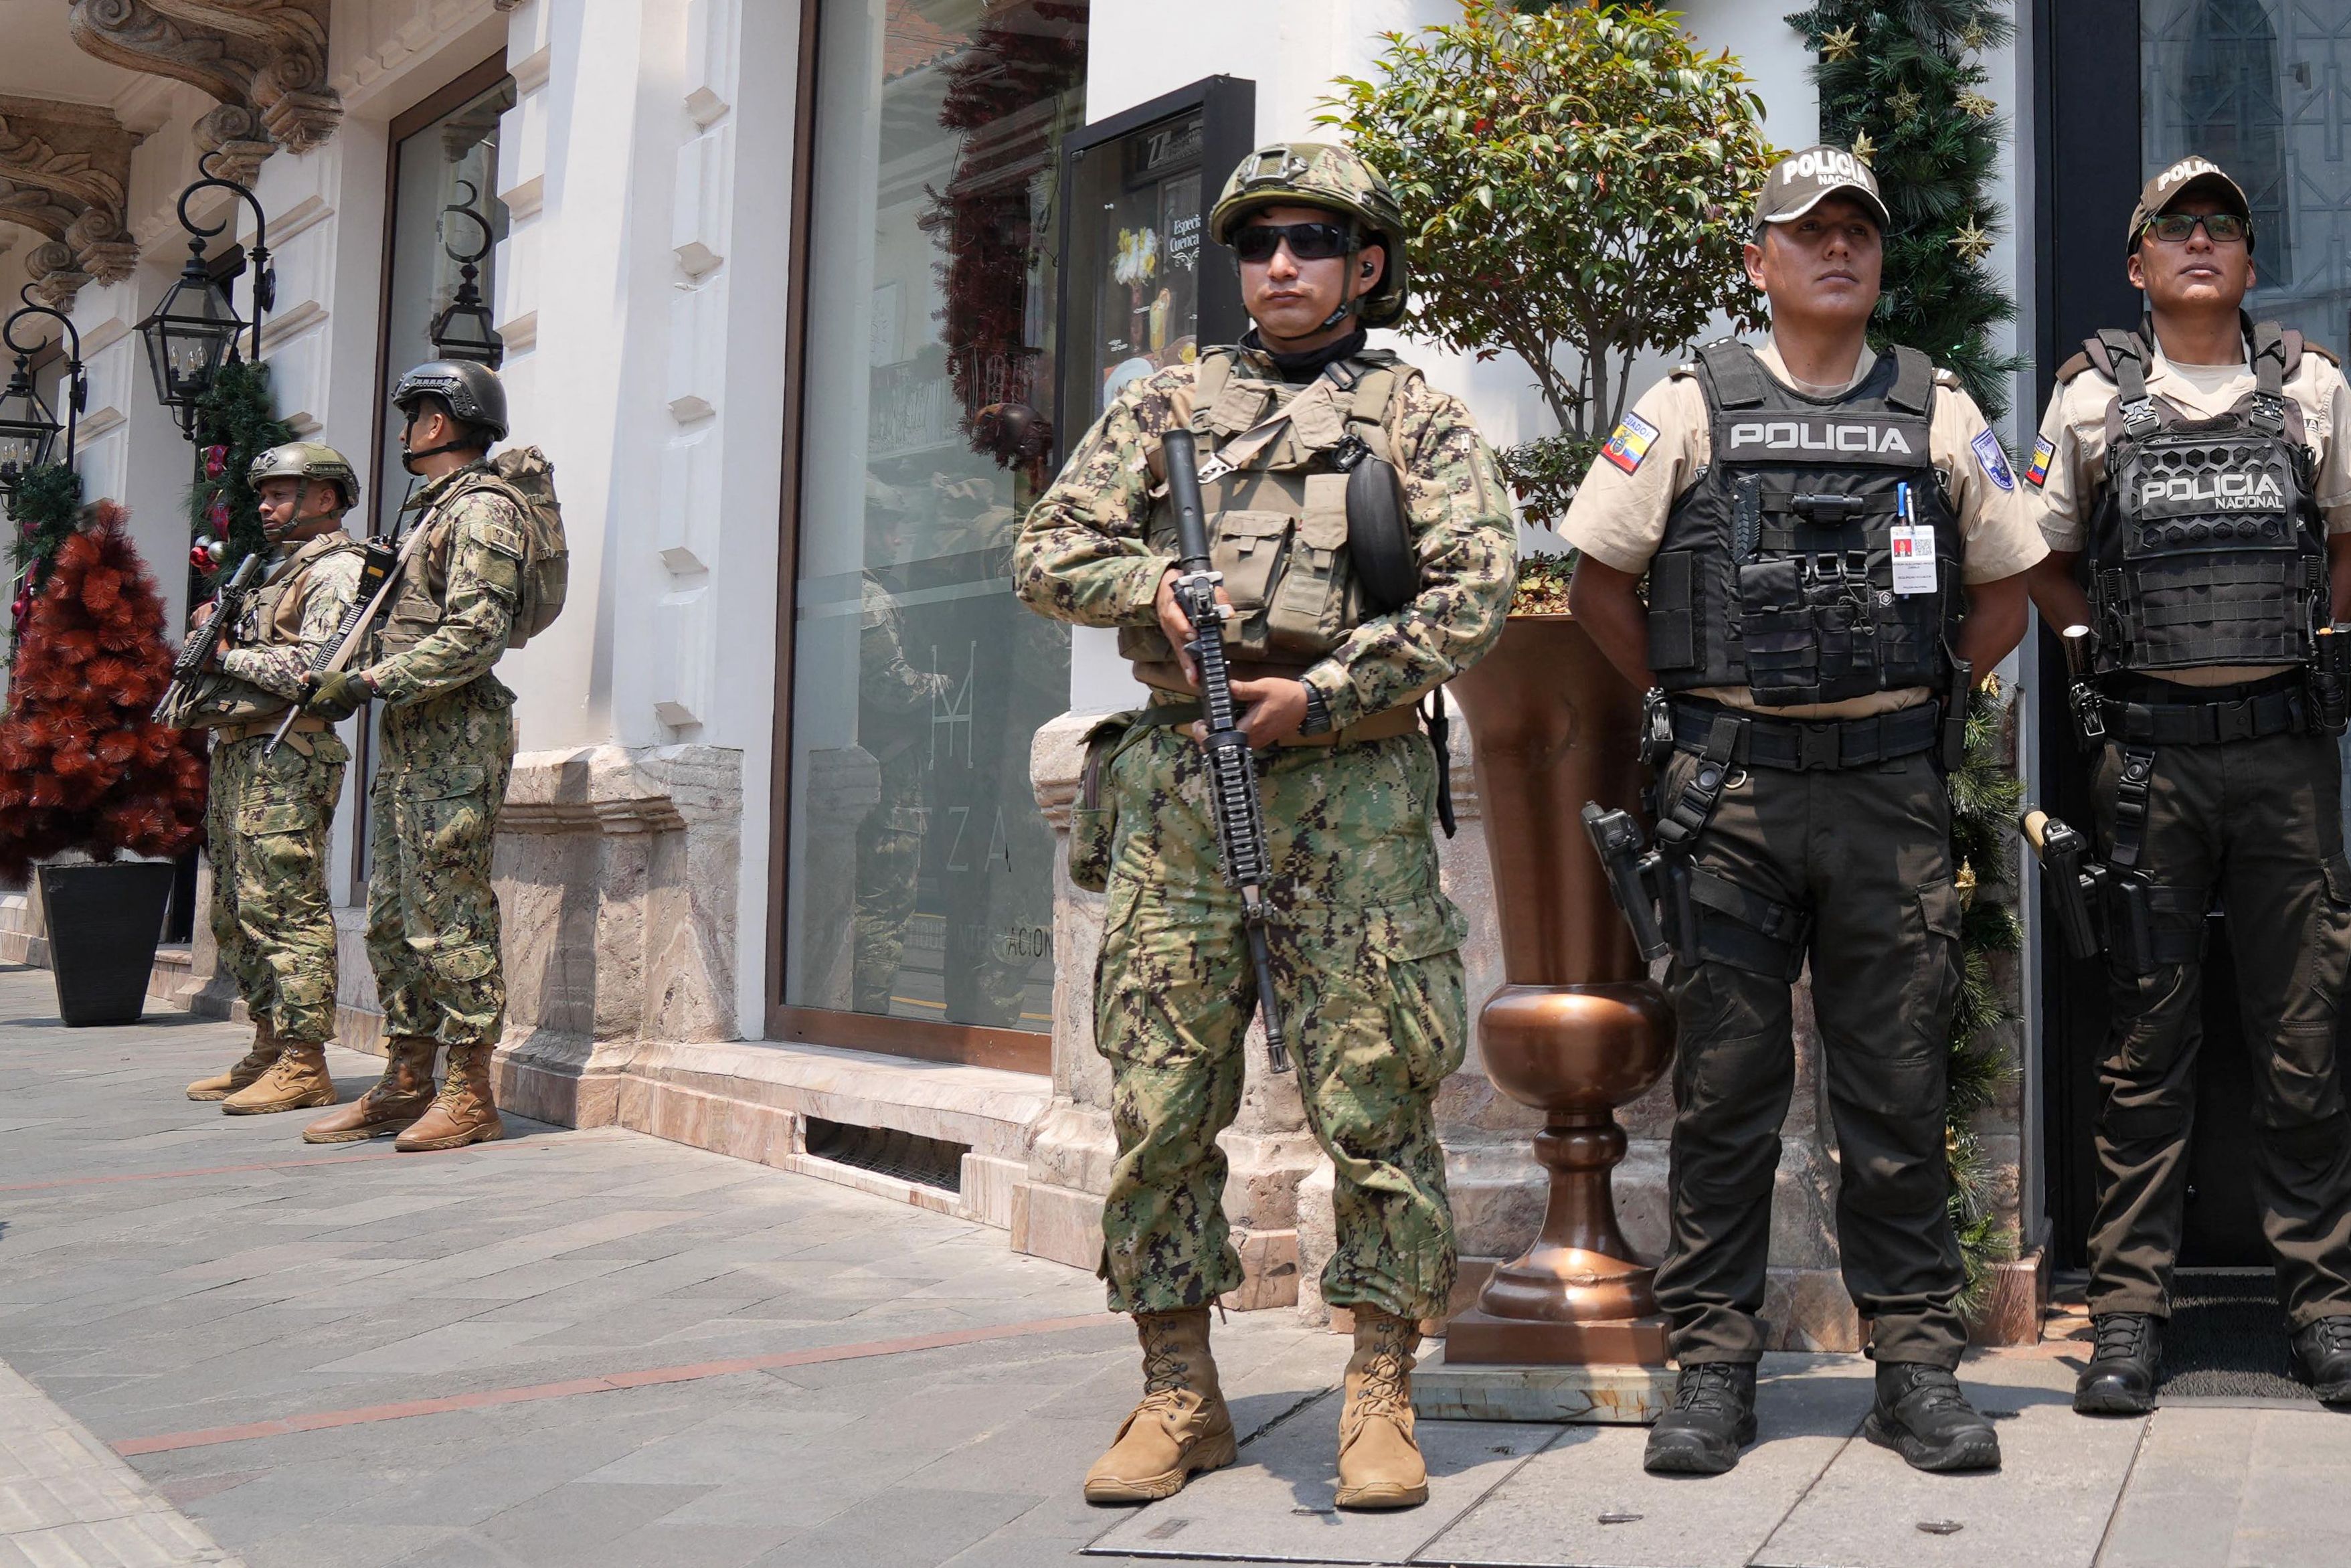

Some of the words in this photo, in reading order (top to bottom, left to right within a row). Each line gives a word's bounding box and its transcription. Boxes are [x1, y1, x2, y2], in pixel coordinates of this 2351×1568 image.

[1782, 151, 1871, 190] POLICIA
[1731, 422, 1912, 454] POLICIA
[2142, 473, 2283, 507] POLICIA
[2214, 496, 2284, 509] NACIONAL
